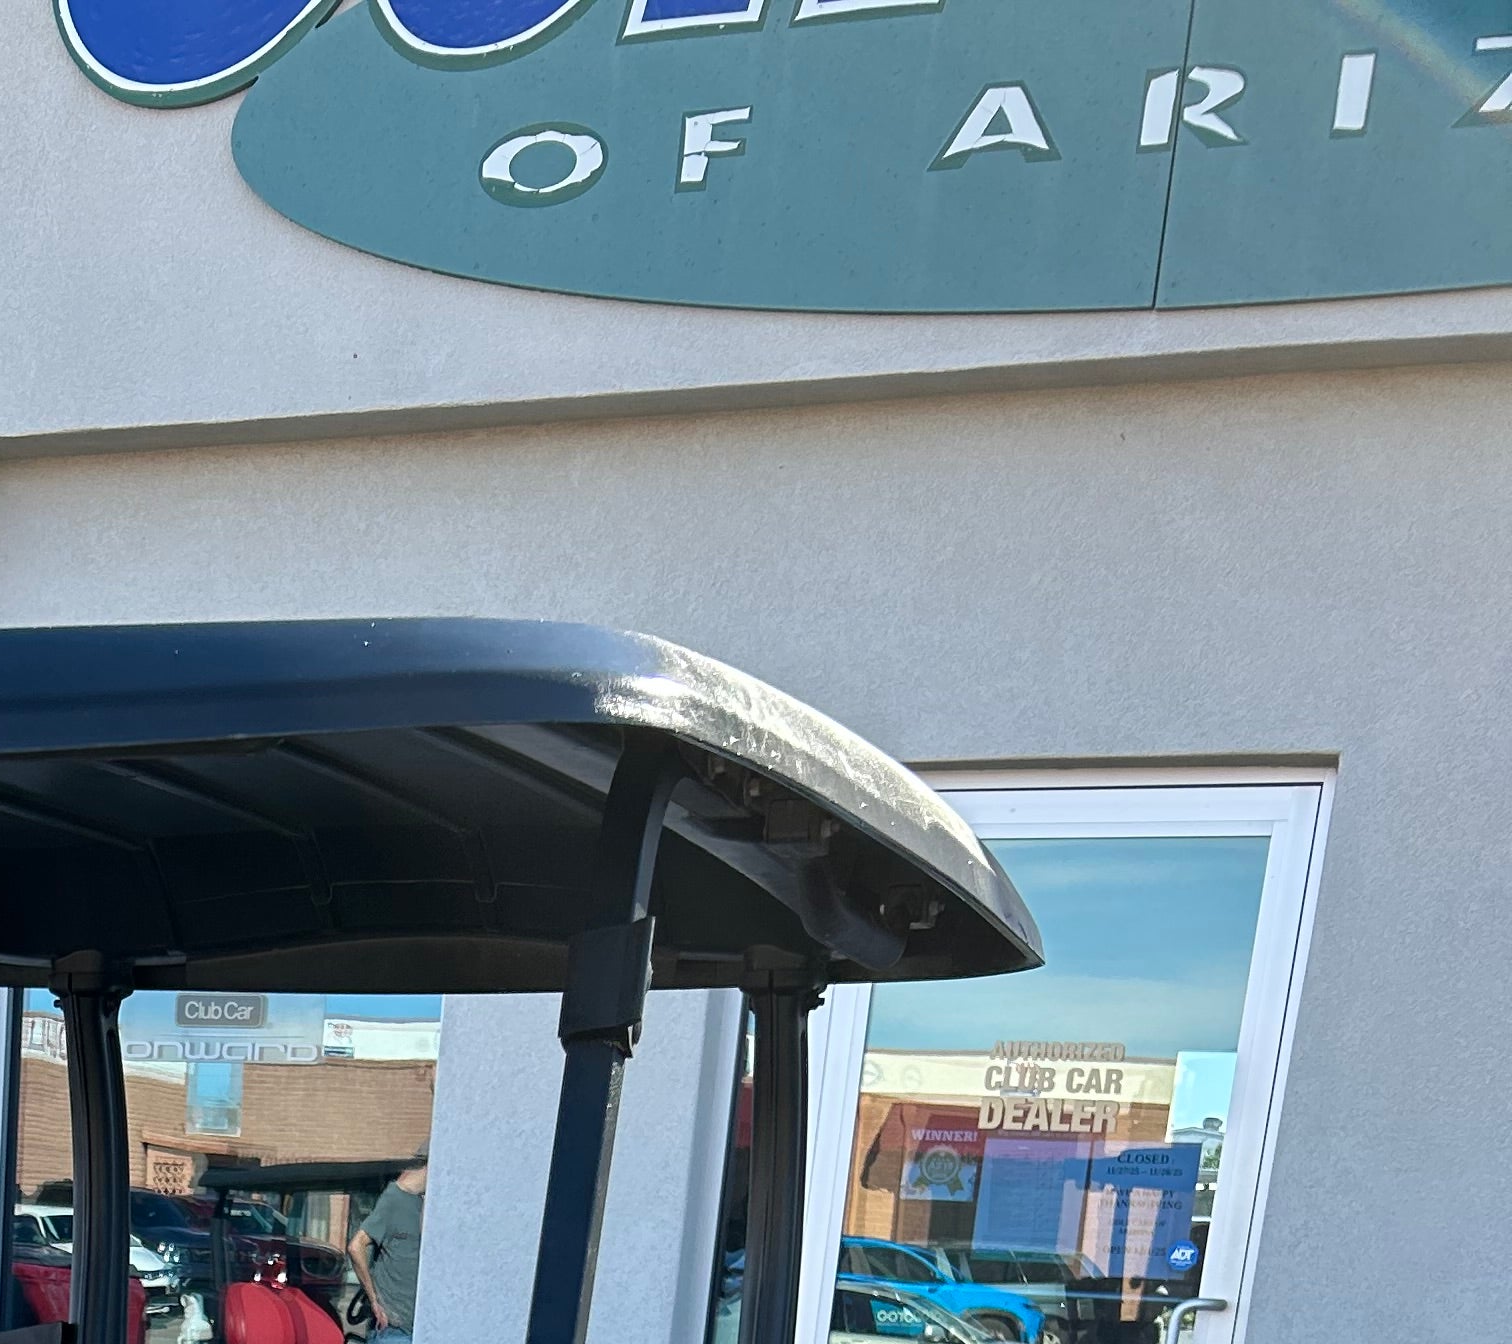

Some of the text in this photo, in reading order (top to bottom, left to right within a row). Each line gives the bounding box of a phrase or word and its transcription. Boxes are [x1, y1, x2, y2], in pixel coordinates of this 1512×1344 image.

[480, 104, 751, 204] OF
[184, 1001, 254, 1020] Club Car
[989, 1040, 1126, 1062] AUTHORIZED
[984, 1065, 1124, 1094] CLUB CAR
[977, 1096, 1120, 1134] DEALER
[911, 1128, 979, 1142] WINNER!
[1117, 1152, 1170, 1165] CLOSED
[1170, 1248, 1195, 1260] ADT
